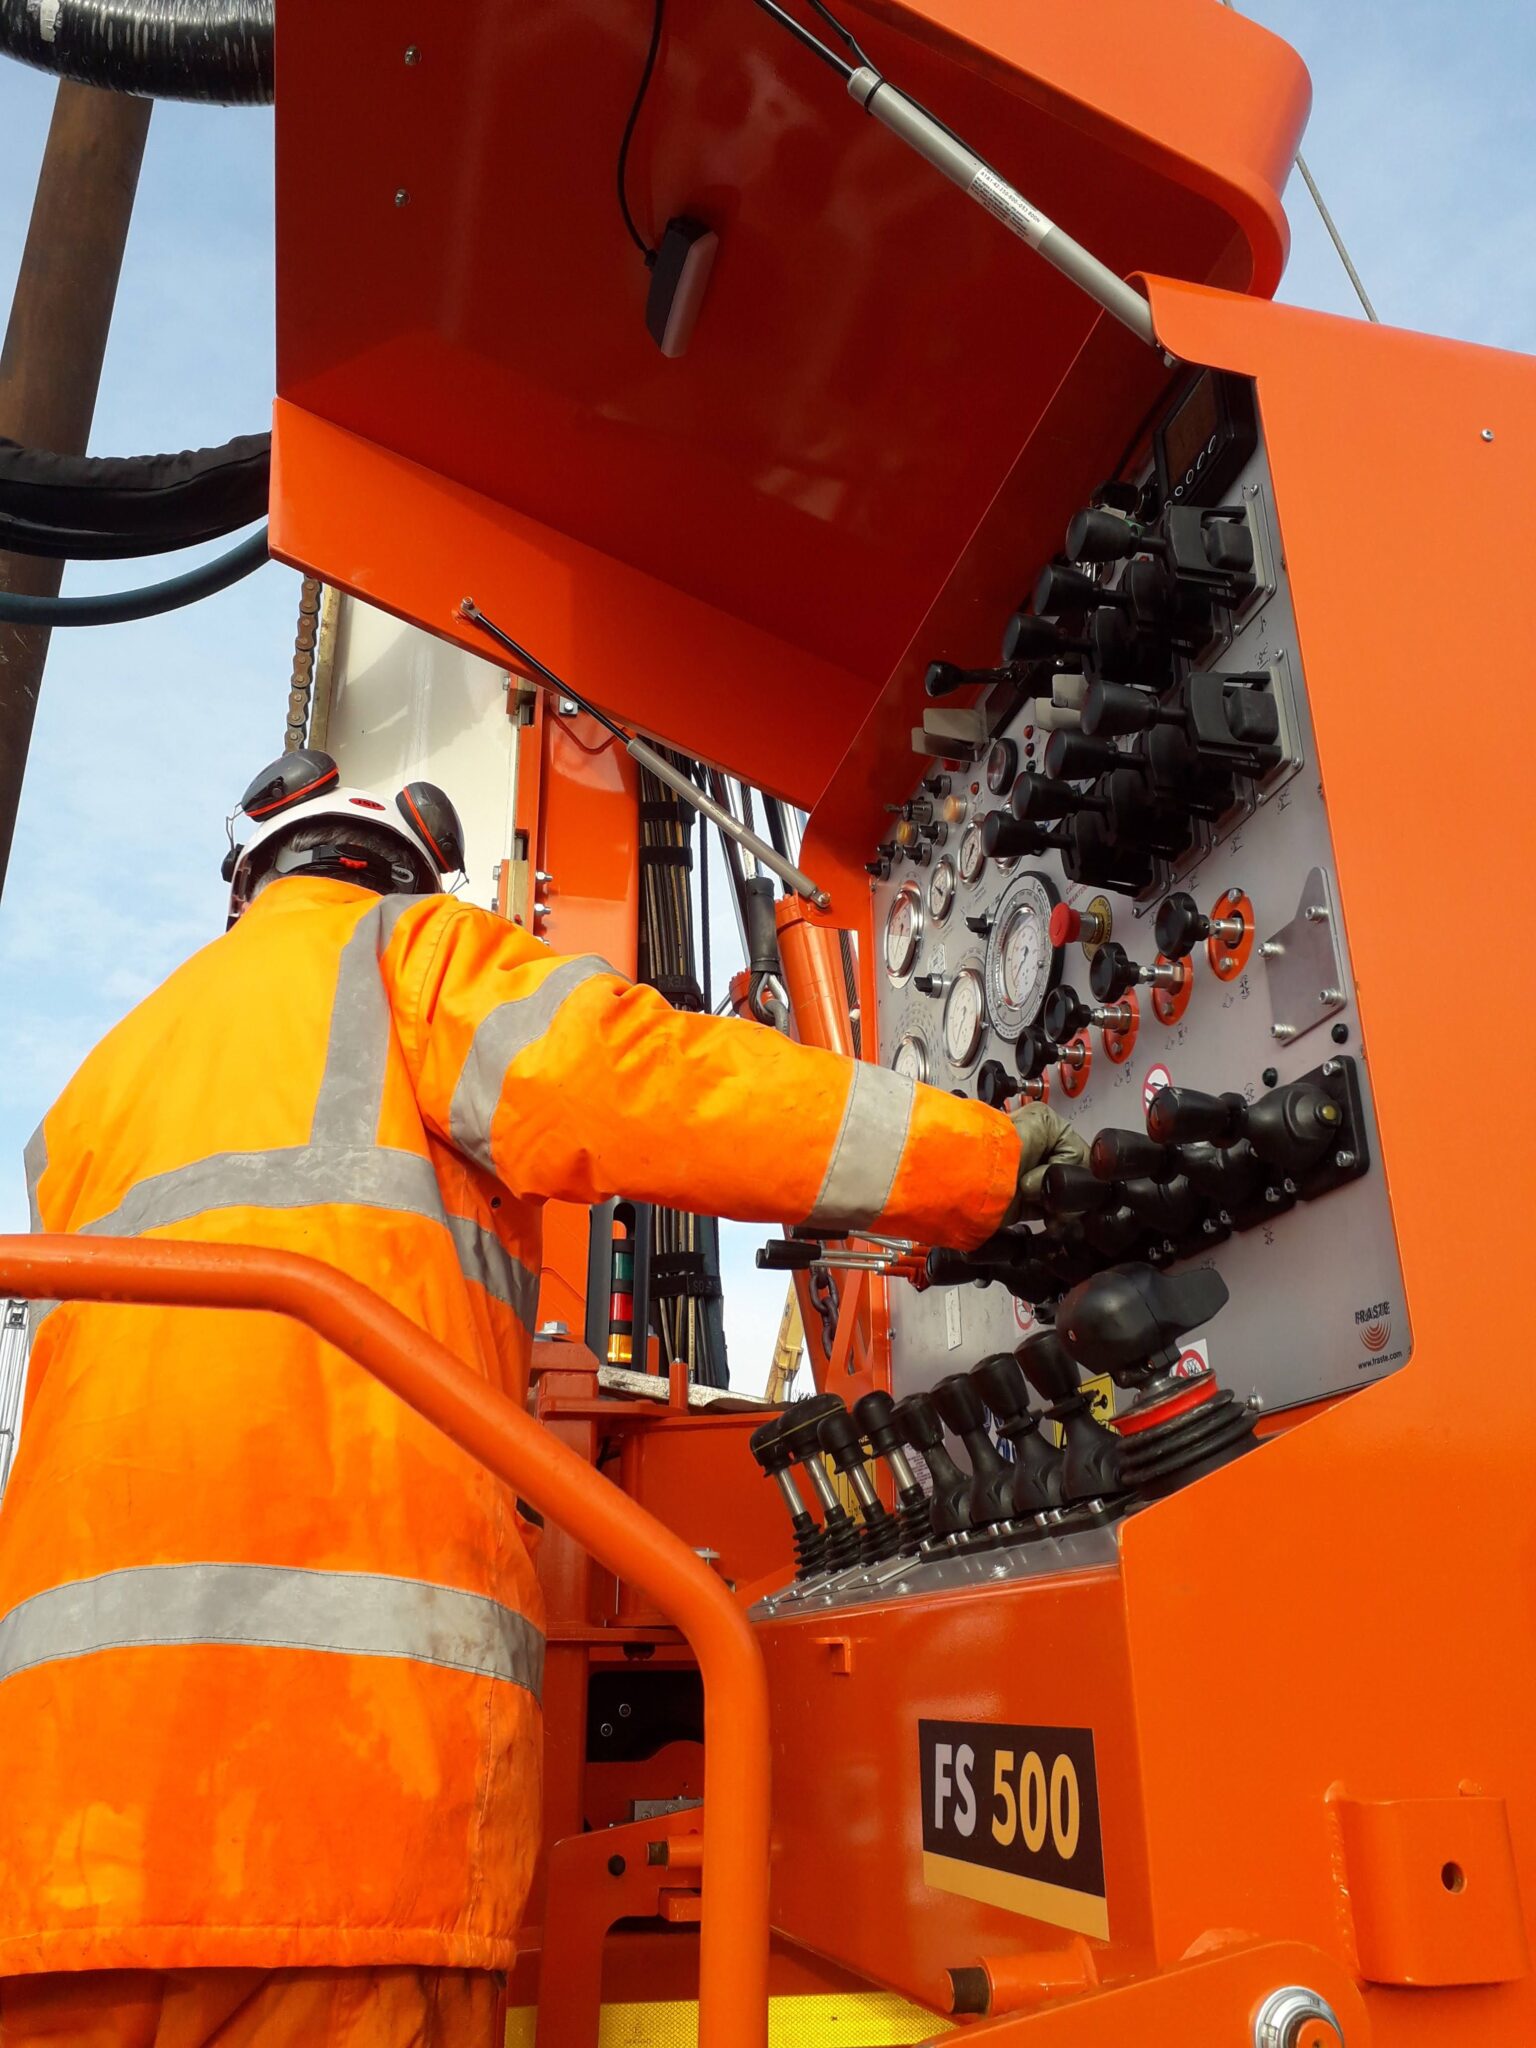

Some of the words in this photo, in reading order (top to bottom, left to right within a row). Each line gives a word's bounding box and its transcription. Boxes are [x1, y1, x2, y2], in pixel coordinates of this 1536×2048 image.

[1355, 1301, 1390, 1325] FRASTE
[1358, 1351, 1402, 1369] www.fraste.com
[935, 1743, 976, 1837] FS
[992, 1749, 1080, 1860] 500
